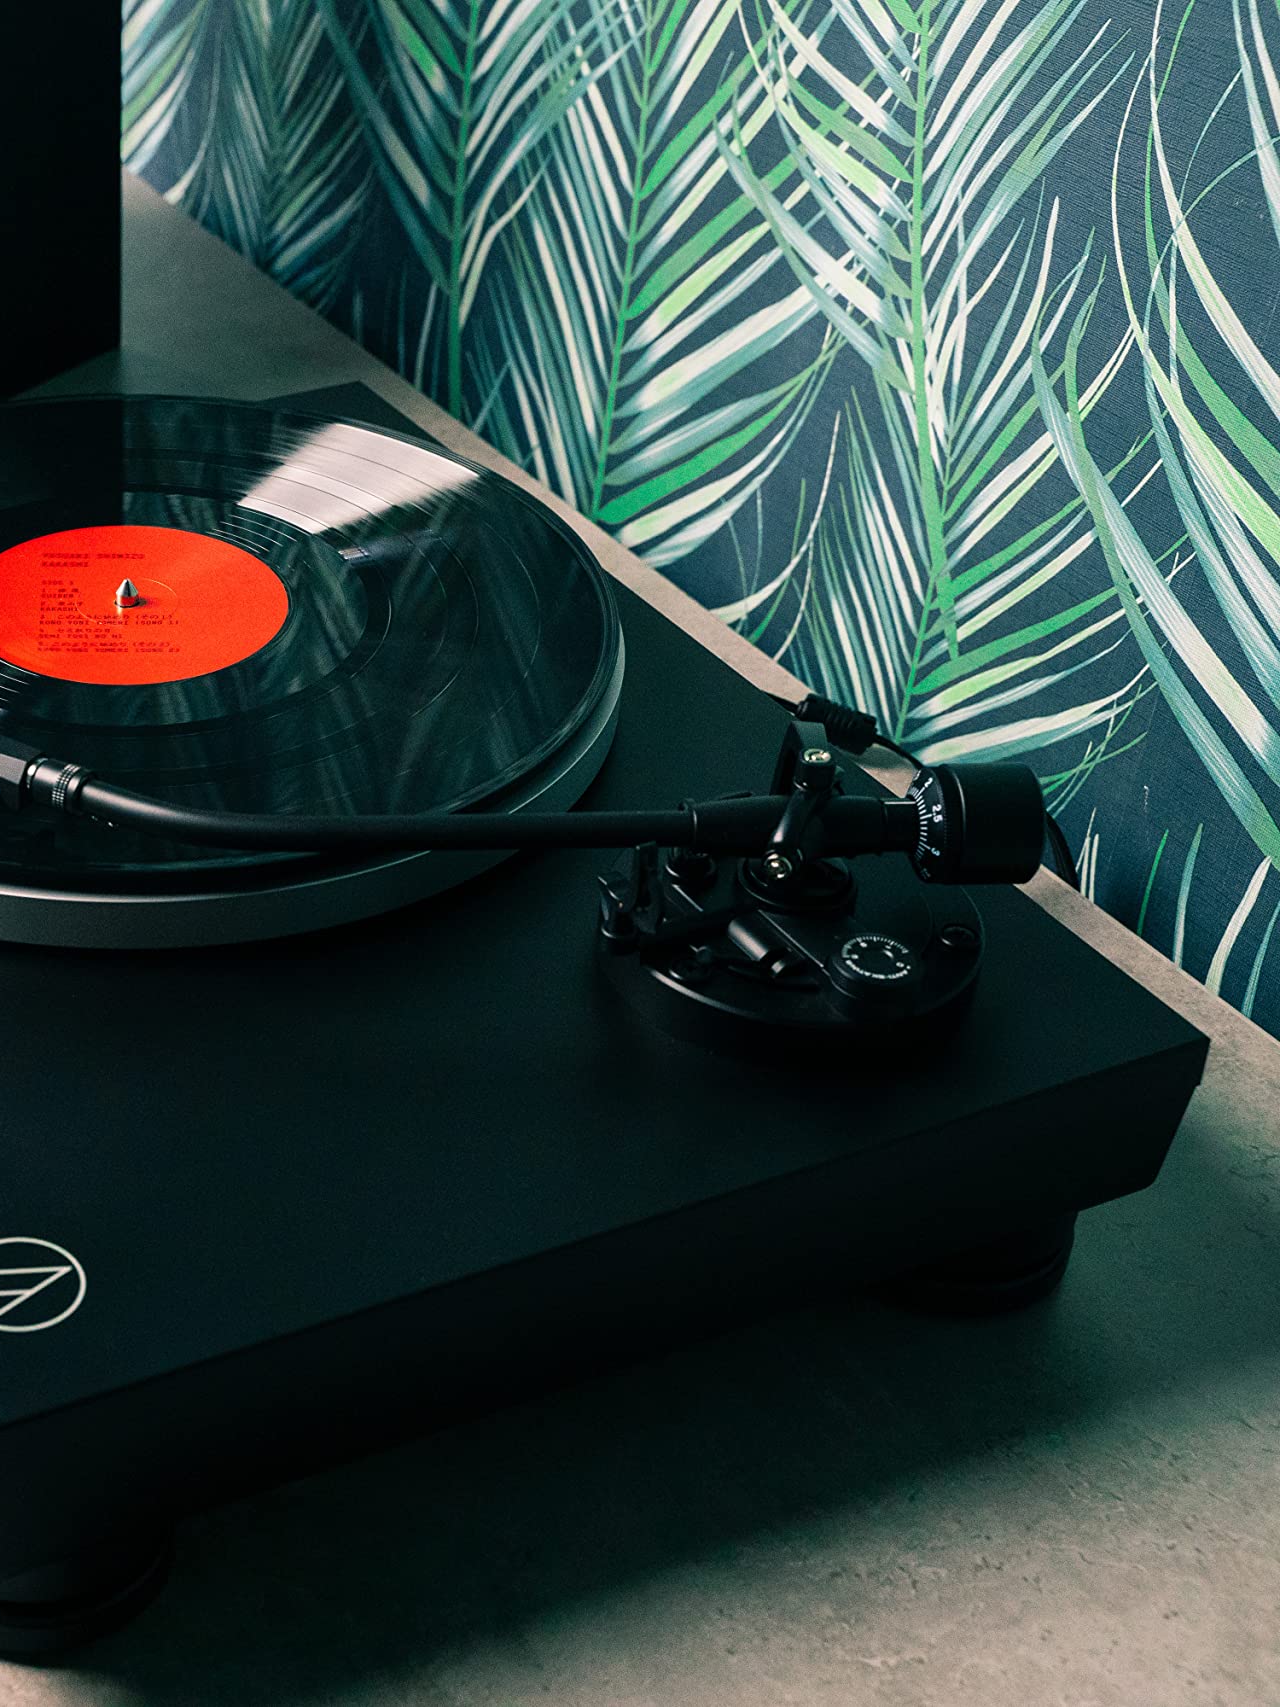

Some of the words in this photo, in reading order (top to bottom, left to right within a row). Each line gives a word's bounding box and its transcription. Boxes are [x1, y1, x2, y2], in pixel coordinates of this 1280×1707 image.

[923, 777, 934, 788] 2
[931, 804, 943, 823] 2.5
[930, 847, 941, 857] 3
